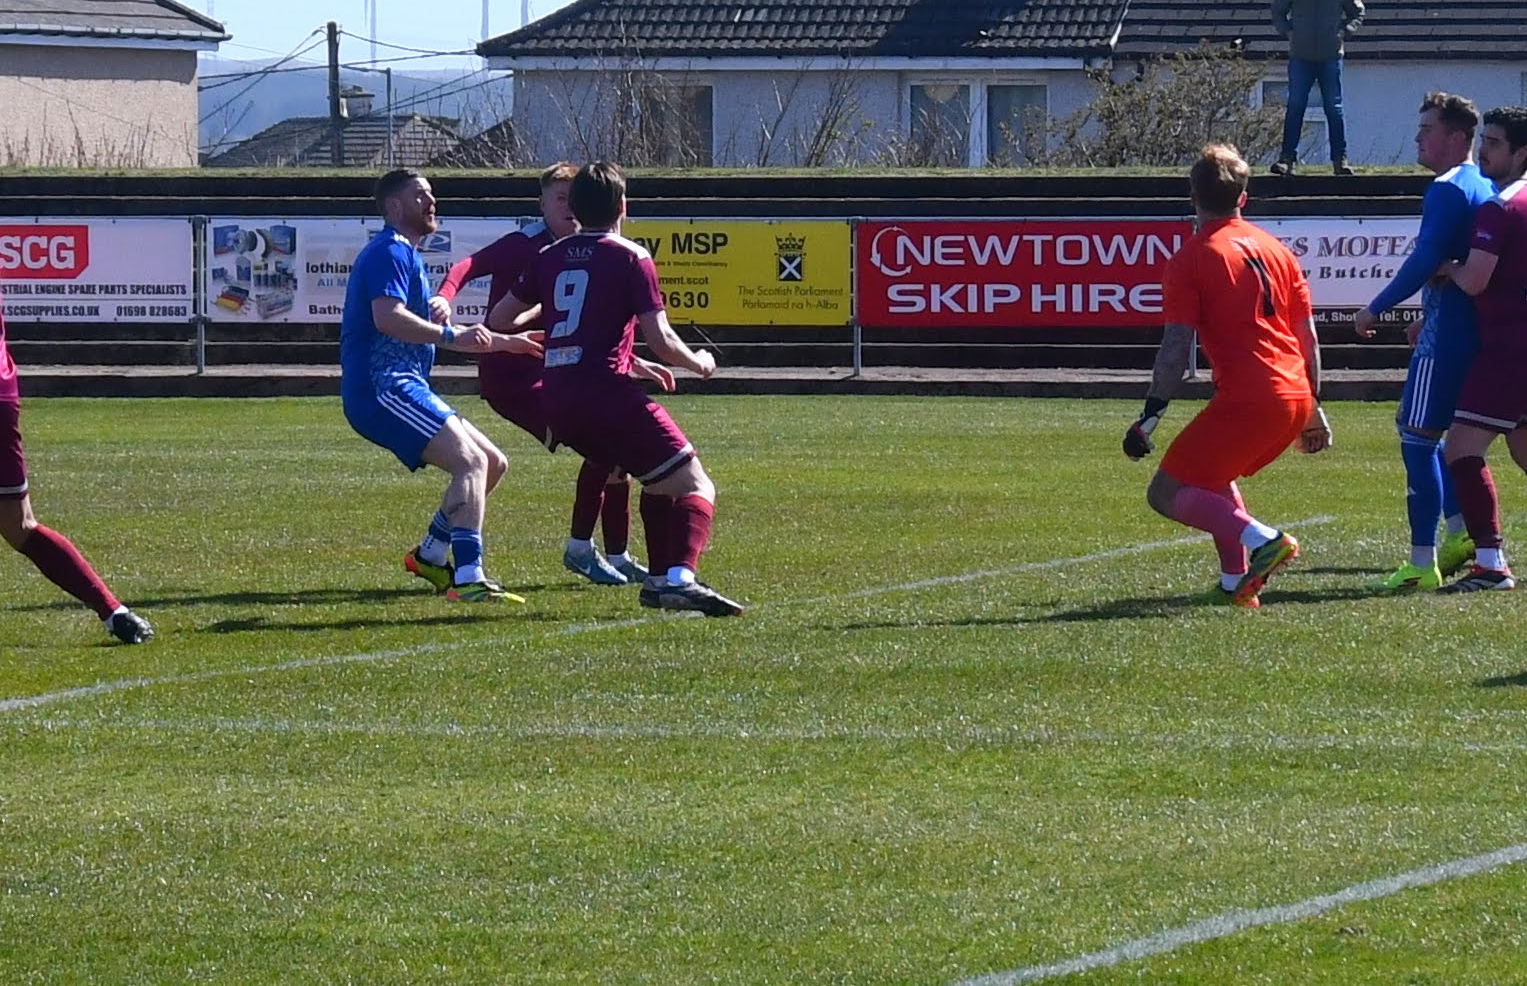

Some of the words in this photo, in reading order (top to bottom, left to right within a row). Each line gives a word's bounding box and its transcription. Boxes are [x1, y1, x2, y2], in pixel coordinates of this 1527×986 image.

[672, 232, 728, 255] MSP
[895, 234, 1182, 266] NEWTOWN
[317, 278, 333, 287] All
[35, 284, 65, 295] ENGINE
[68, 284, 96, 295] SPARE
[99, 284, 128, 295] PARTS
[130, 284, 187, 295] SPECIALISTS
[738, 286, 754, 296] The
[757, 286, 792, 296] Scottish
[794, 286, 843, 296] Parliament
[886, 283, 1021, 313] SKIP
[1031, 283, 1163, 313] HIRE
[551, 269, 589, 339] 9
[792, 302, 804, 310] na
[806, 299, 839, 310] h-Alba
[116, 306, 146, 317] 01698
